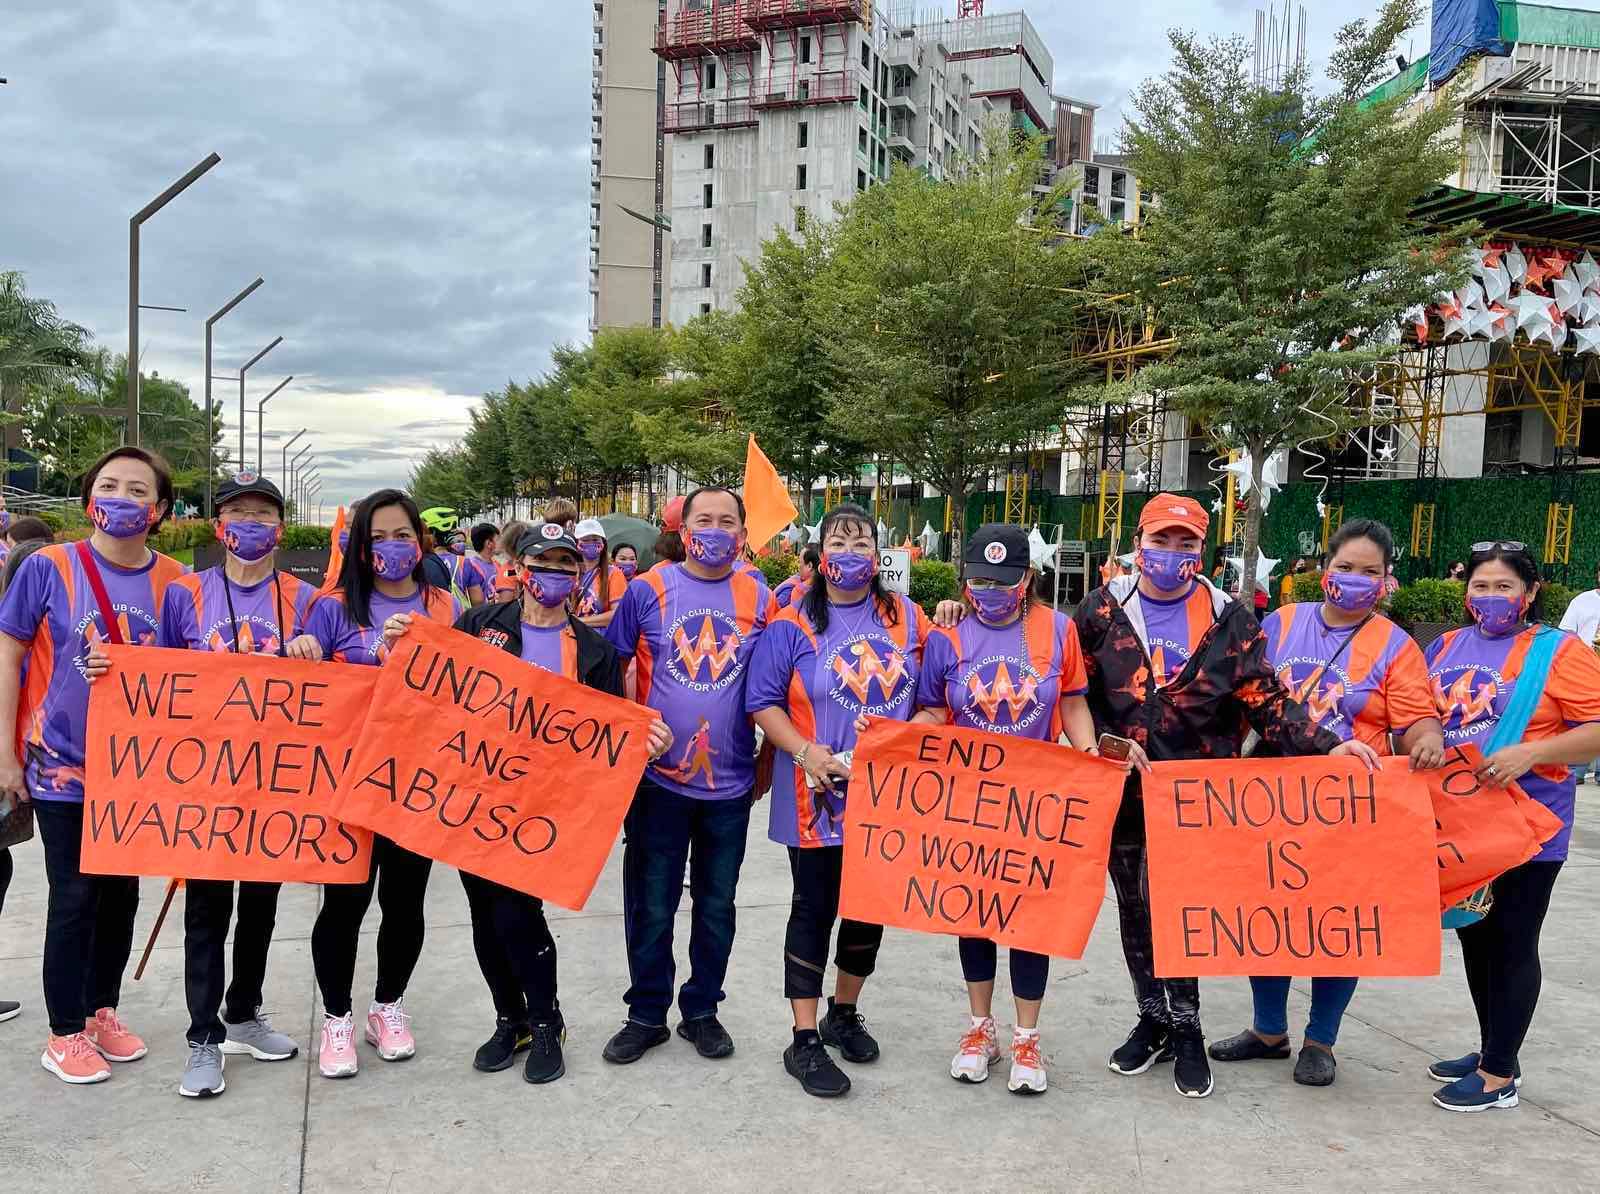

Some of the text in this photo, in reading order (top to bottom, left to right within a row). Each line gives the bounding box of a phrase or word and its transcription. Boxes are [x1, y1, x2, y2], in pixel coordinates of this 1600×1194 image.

[880, 555, 893, 567] O
[880, 570, 903, 582] TRY
[74, 609, 100, 635] ZONTA
[112, 603, 128, 612] UB
[130, 606, 143, 617] OF
[251, 616, 265, 624] OF
[666, 615, 688, 640] ZONTA
[688, 608, 711, 617] CLUB
[713, 609, 726, 618] OF
[725, 616, 743, 638] CEBU
[368, 633, 385, 657] ZONT
[824, 645, 843, 672] ZONTA
[1165, 640, 1180, 650] OF
[72, 655, 89, 681] WAL
[666, 658, 744, 692] WALK FOR WOMEN
[960, 663, 983, 687] ZONTA
[983, 655, 1006, 665] CLUB
[1007, 656, 1020, 665] OF
[1275, 656, 1301, 674] ONTA
[1302, 656, 1327, 667] CLUB
[1454, 663, 1480, 671] CLUB
[120, 671, 329, 727] WE ARE
[403, 644, 630, 768] UNDANGON
[829, 676, 916, 715] WALK FOR WOMEN
[962, 702, 1047, 735] WALK FOR WOMEN
[1443, 729, 1456, 739] OR
[109, 734, 352, 795] WOMEN
[438, 730, 531, 782] ANG
[917, 735, 1006, 773] END
[353, 757, 558, 855] ABUSO
[866, 761, 1090, 848] VIOLENCE
[1172, 773, 1377, 828] ENOUGH
[90, 799, 358, 864] WARRIORS
[858, 823, 1055, 890] TO WOMEN
[1266, 839, 1310, 891] IS
[1182, 904, 1383, 958] ENOUGH
